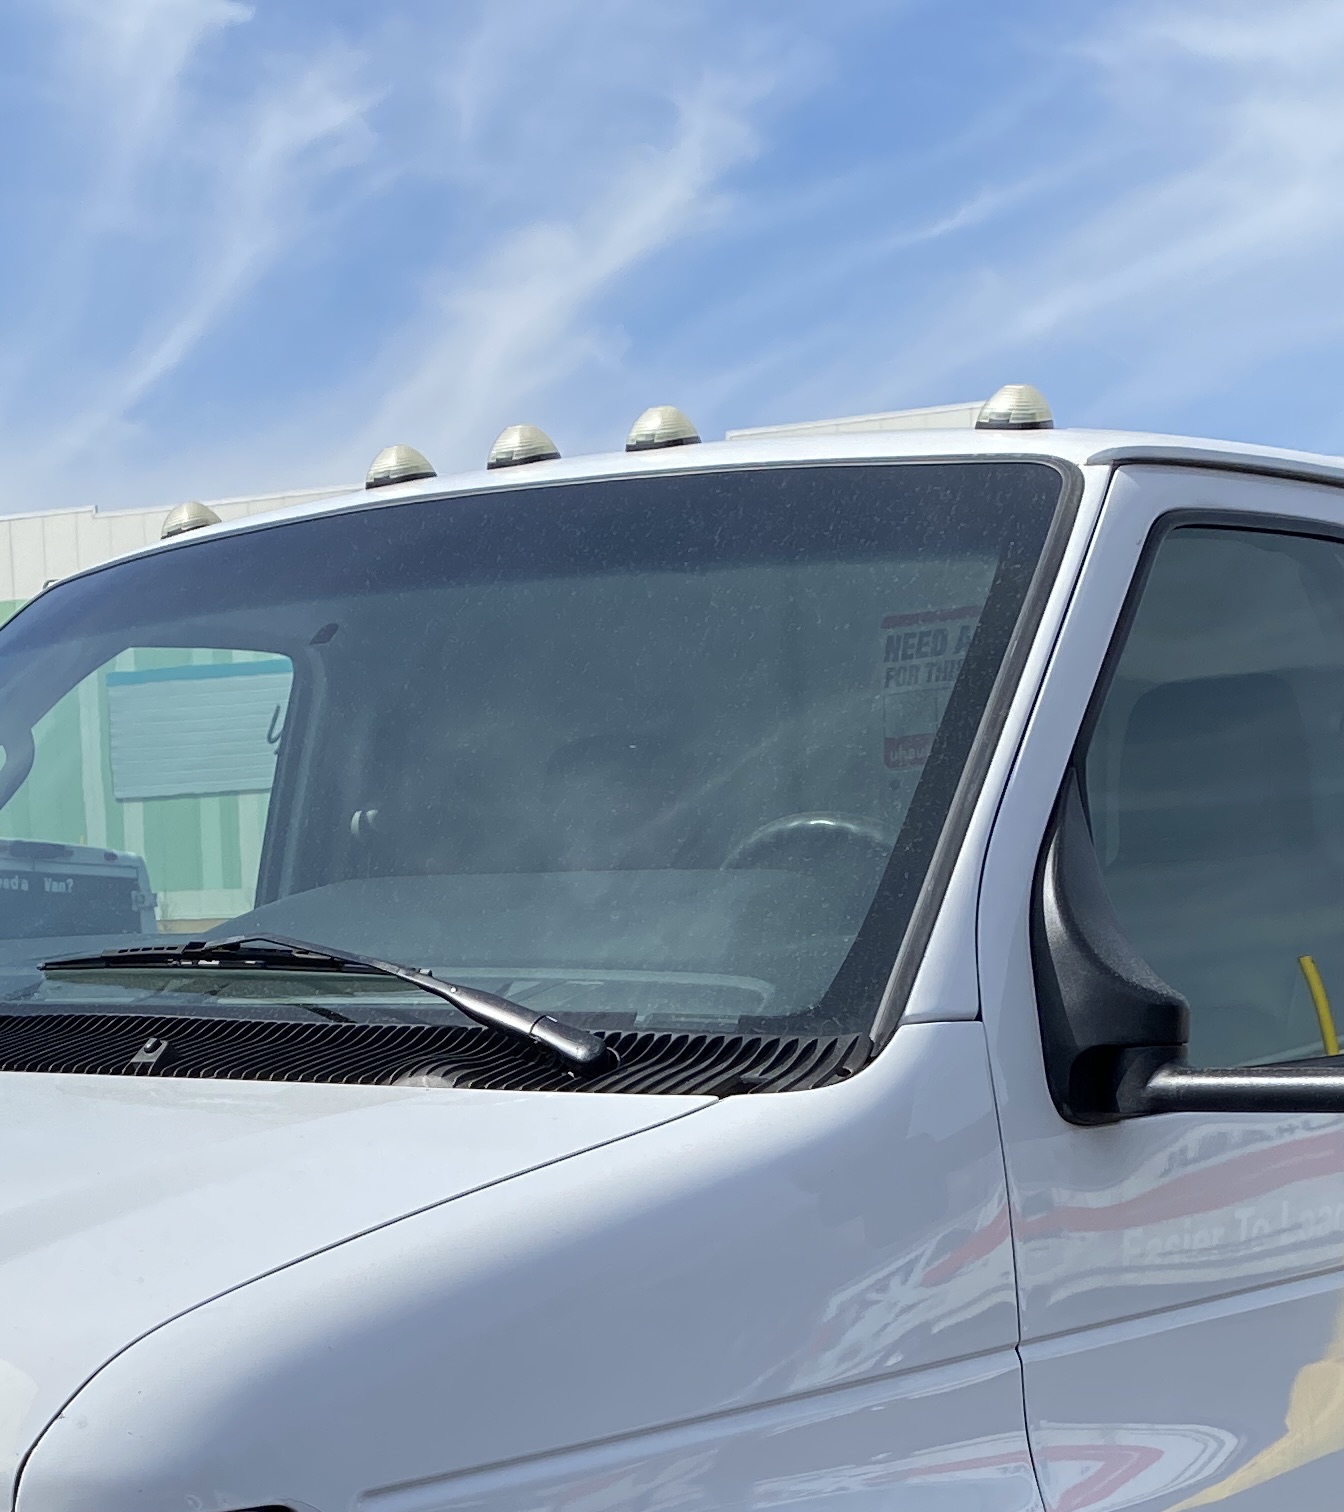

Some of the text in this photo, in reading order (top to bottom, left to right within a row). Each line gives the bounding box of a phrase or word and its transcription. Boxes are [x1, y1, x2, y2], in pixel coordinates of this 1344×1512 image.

[884, 628, 949, 663] NEED
[884, 663, 921, 689] FOR
[43, 877, 74, 894] Van?
[1121, 1219, 1225, 1265] Easier
[1234, 1209, 1266, 1241] To
